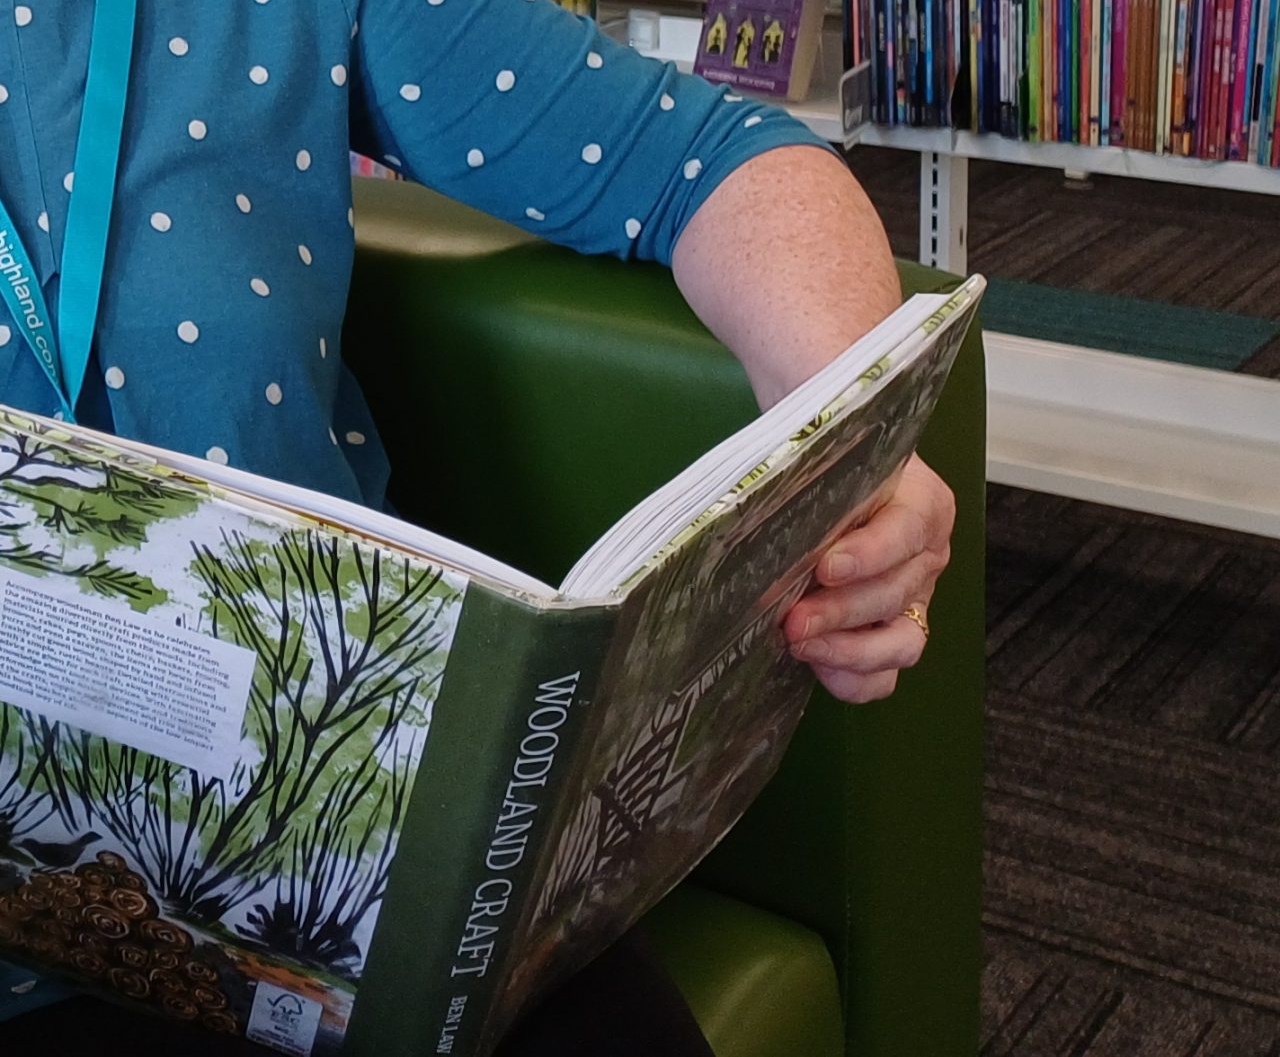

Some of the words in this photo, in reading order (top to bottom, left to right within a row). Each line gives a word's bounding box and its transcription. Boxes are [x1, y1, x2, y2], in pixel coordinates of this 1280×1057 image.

[20, 594, 57, 613] amazing
[58, 605, 96, 626] diversity
[45, 611, 79, 627] sourced
[80, 621, 113, 640] directly
[115, 633, 137, 647] from
[485, 670, 581, 871] WOODLAND
[450, 878, 512, 978] CRAFT
[446, 994, 469, 1024] BEN
[437, 1024, 462, 1055] LAW
